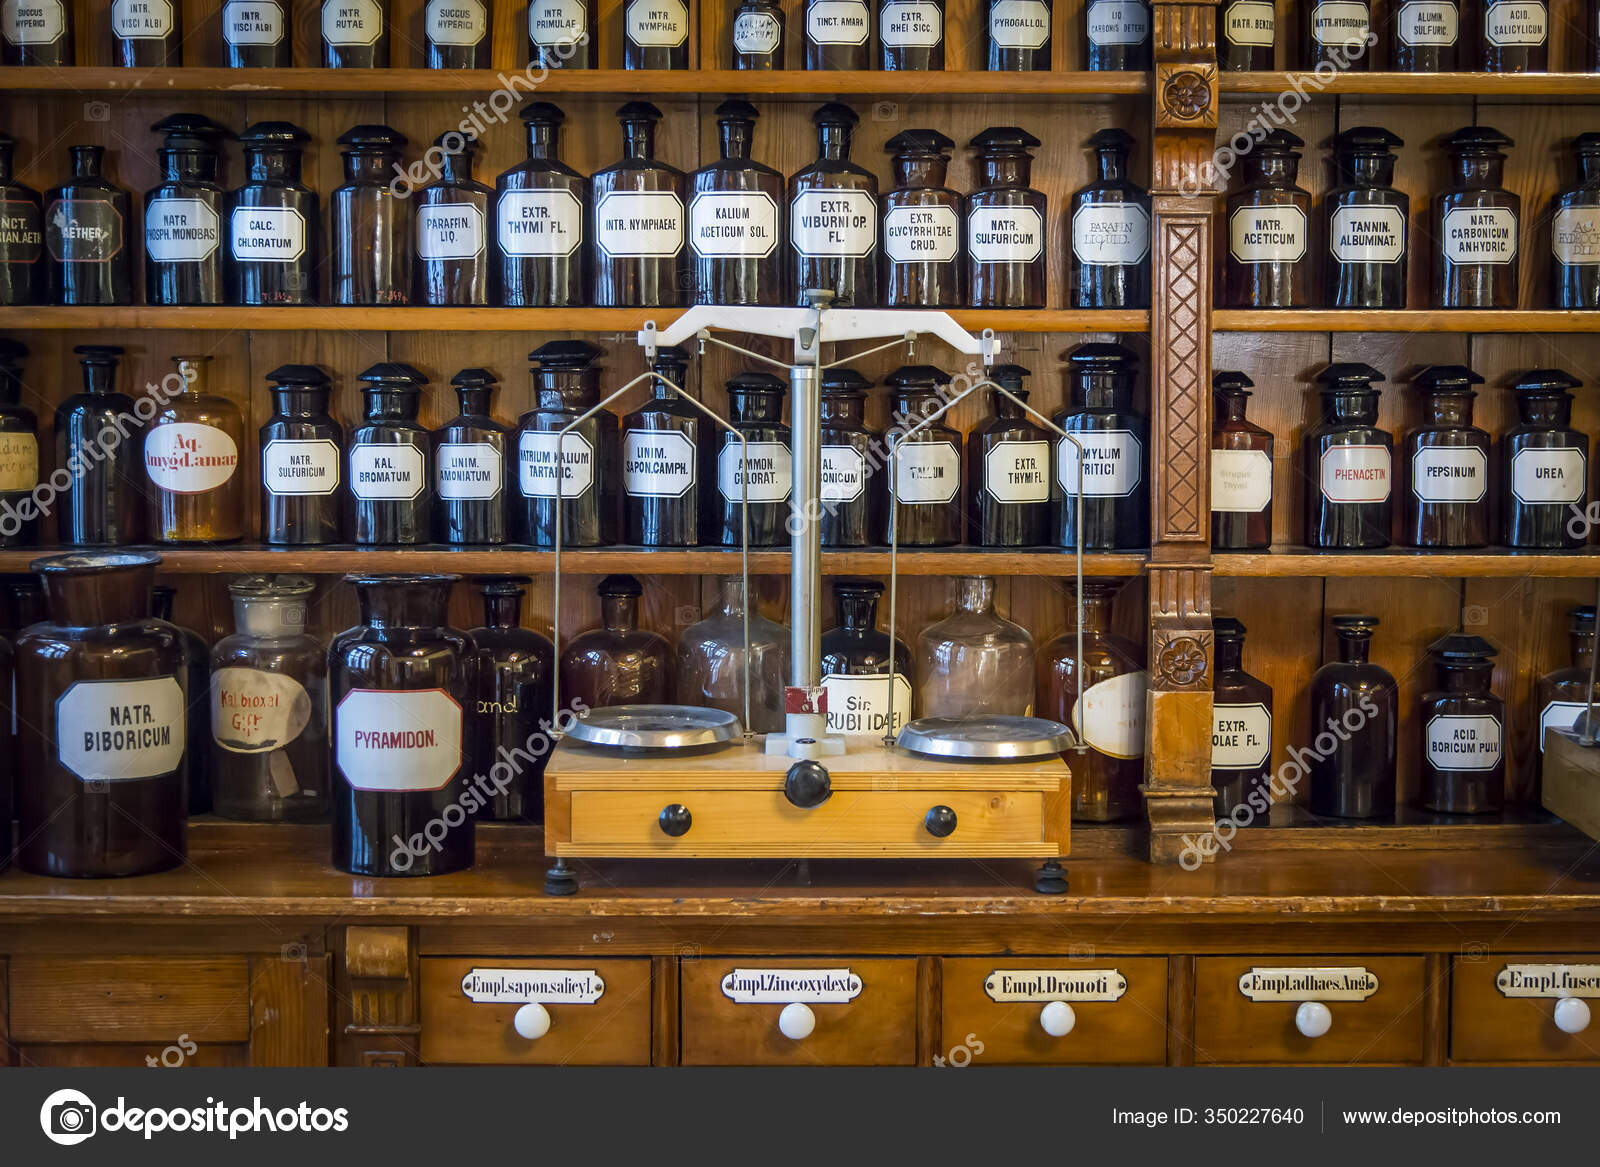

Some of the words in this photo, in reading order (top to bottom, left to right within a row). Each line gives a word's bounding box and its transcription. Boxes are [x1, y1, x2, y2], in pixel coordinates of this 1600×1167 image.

[17, 9, 43, 17] SUCCUS
[440, 9, 471, 18] SUCCUS
[901, 12, 925, 22] EXTR.
[121, 19, 140, 28] VISCI
[145, 19, 162, 28] ALBI
[233, 23, 253, 32] VISCI
[255, 23, 273, 32] ALBI
[336, 20, 364, 29] RUTAE
[438, 20, 473, 29] HYPERICI
[536, 20, 576, 29] PRIMULAE
[639, 22, 677, 31] NYMPHAE
[816, 17, 839, 26] TINCT.
[841, 17, 864, 27] AMARA
[890, 23, 909, 33] RHEI
[913, 23, 933, 33] SICC.
[1494, 25, 1543, 35] SALICYLICUM
[522, 206, 551, 218] EXTR.
[715, 207, 750, 220] KALIUM
[820, 201, 852, 214] EXTR.
[801, 216, 850, 229] VIBURNI
[852, 216, 867, 229] OP.
[910, 213, 935, 224] EXTR.
[1470, 215, 1498, 226] NATR.
[249, 220, 276, 232] CALC.
[508, 220, 544, 234] THYMI
[551, 221, 567, 234] FL.
[605, 219, 627, 231] INTR.
[629, 218, 677, 232] NYMPHAEAE
[991, 220, 1019, 232] NATR.
[1255, 220, 1284, 232] NATR.
[1350, 221, 1391, 234] TANNIN.
[63, 226, 102, 239] AETHER
[700, 226, 745, 239] ACETICUM
[750, 226, 769, 239] SOL.
[828, 230, 845, 243] FL.
[889, 226, 952, 238] GLYCYRRHIZAE
[1451, 227, 1509, 240] CARBONICUM
[237, 238, 292, 249] CHLORATUM
[910, 239, 938, 251] CRUD.
[975, 233, 1034, 245] SULFURICUM
[1243, 233, 1295, 246] ACETICUM
[1340, 234, 1397, 247] ALBUMINAT.
[1458, 241, 1508, 254] ANHYDRIC.
[174, 433, 202, 453] Aq.
[520, 450, 551, 463] NATRIUM
[637, 447, 667, 460] LINIM.
[290, 455, 313, 466] NATR.
[374, 457, 396, 469] KAL.
[278, 467, 326, 478] SULFURICUM
[359, 470, 411, 483] BROMATUM
[1335, 468, 1386, 480] PHENACETIN
[1427, 466, 1476, 478] PEPSINUM
[1536, 467, 1564, 479] UREA
[110, 704, 156, 727] NATR.
[826, 711, 862, 731] RUBI
[1218, 720, 1248, 733] EXTR.
[84, 726, 171, 752] BIBORICUM
[354, 729, 439, 750] PYRAMIDON.
[1246, 734, 1261, 747] FL.
[1453, 729, 1479, 741] ACID.
[1432, 742, 1476, 754] BORICUM
